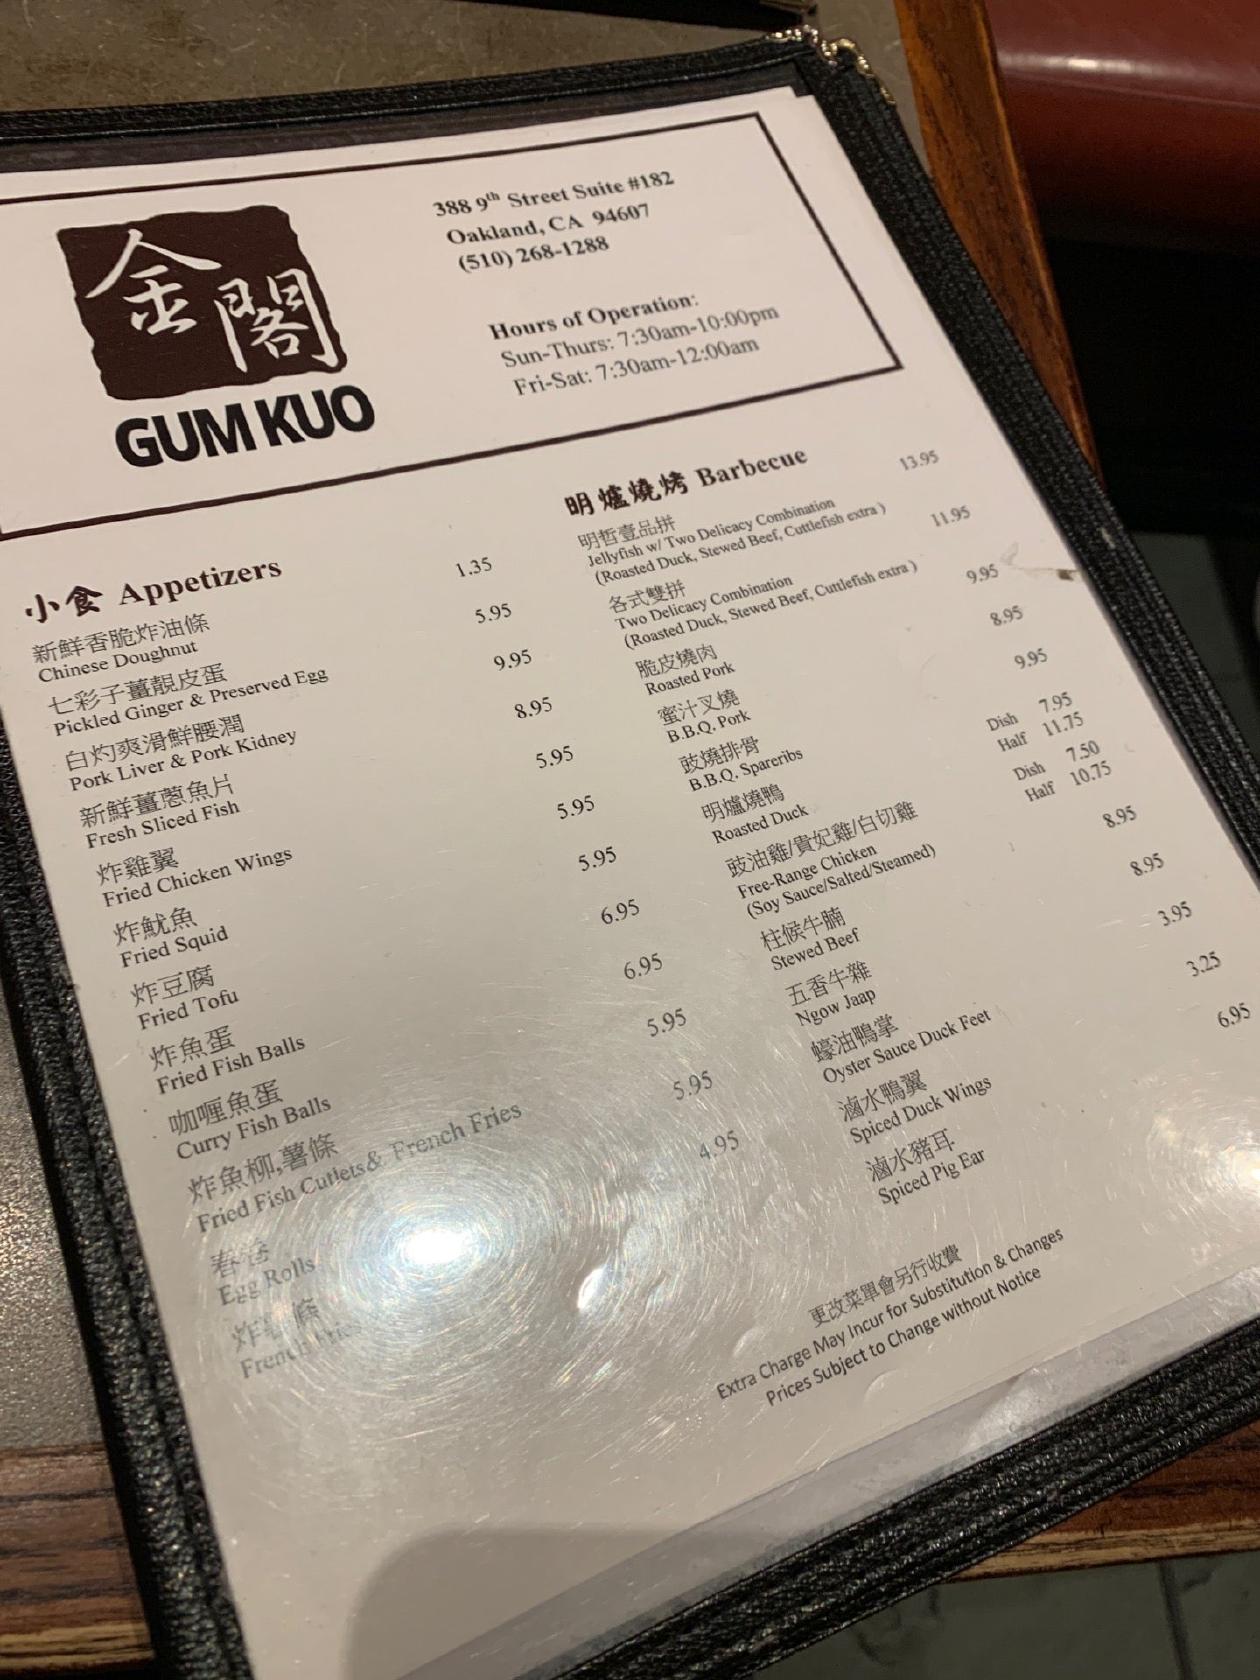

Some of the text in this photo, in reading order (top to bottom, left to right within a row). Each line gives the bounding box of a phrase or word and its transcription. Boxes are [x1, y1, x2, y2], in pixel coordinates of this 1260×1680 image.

[433, 199, 472, 217] 388
[507, 188, 570, 207] Street
[572, 181, 625, 199] Suite
[627, 171, 675, 191] #182
[446, 203, 648, 244] Oakland, CA 94607
[459, 236, 609, 273] (510) 268-1288
[84, 228, 342, 374] 金閣
[488, 295, 698, 340] Hours of Operation:
[501, 308, 779, 368] Sun-Thurs: 7:30am-10:00pm
[513, 340, 759, 396] Fri-Sat: 7:30am-12:00am
[115, 385, 375, 468] GUM KUO
[694, 451, 808, 487] Barbecue
[900, 450, 939, 470] 13.95
[587, 500, 836, 567] Jellyfish Two Delicacy Combination
[931, 506, 970, 527] 11.95
[456, 557, 492, 577] 1.35
[595, 514, 844, 586] (Roasted Duck, Stewed Beef, Cuttlefish
[25, 563, 282, 624] 小食 Appetizers
[966, 564, 998, 584] 9.95
[475, 603, 511, 624] 5.95
[614, 577, 794, 630] Two Delicacy Combination
[990, 605, 1023, 626] 8.95
[32, 613, 210, 663] 新鮮香脆炸油條
[38, 641, 199, 682] Chinese Doughnut
[494, 649, 531, 671] 9.95
[635, 644, 718, 679] 脆皮燒肉
[644, 661, 736, 696] Roasted Pork
[1014, 648, 1047, 669] 9.95
[53, 670, 329, 736] Pickled Ginger Preserved Egg
[514, 697, 552, 718] 8.95
[657, 689, 740, 726] 蜜汁叉燒
[986, 692, 1073, 731] Dish 7.95
[666, 709, 751, 743] B.B.Q. Pork
[997, 712, 1084, 752] Half 11.75
[69, 731, 296, 791] Pork Liver Pork Kidney
[536, 745, 573, 769] 5.95
[678, 736, 760, 774] 豉燒排骨
[688, 749, 803, 792] B.B.Q. Spareribs
[1012, 740, 1100, 780] Dish 7.50
[1025, 760, 1112, 802] Half 10.75
[557, 795, 594, 819] 5.95
[701, 784, 785, 823] 明爐燒鴨
[1102, 805, 1136, 828] 8.95
[85, 801, 240, 849] Fresh Sliced Fish
[711, 804, 809, 844] Roasted Duck
[96, 847, 179, 886] 炸雞翼
[102, 850, 293, 907] Fried Chicken Wings
[579, 846, 616, 871] 5.95
[736, 845, 878, 899] Free-Range Chicken
[1130, 853, 1164, 876] 8.95
[113, 907, 198, 947] 炸魷魚
[601, 899, 639, 924] 6.95
[747, 898, 779, 920] (Soy
[1158, 901, 1192, 926] 3.95
[120, 925, 229, 968] Fried Squid
[760, 907, 846, 952] 柱候牛腩
[771, 927, 860, 971] Stewed Beef
[624, 953, 662, 979] 6.95
[785, 961, 872, 1006] 五香牛雜
[1186, 951, 1221, 977] 3.25
[130, 964, 214, 1007] 炸豆腐
[137, 990, 239, 1030] Fried Tofu
[647, 1008, 687, 1038] 5.95
[794, 990, 876, 1026] Ngow Jaap
[1217, 1002, 1250, 1028] 6.95
[149, 1025, 235, 1072] 炸魚蛋
[810, 1014, 899, 1064] 蠔油鴨掌
[823, 1009, 991, 1083] Oyster Sauce Duck Feet
[156, 1037, 305, 1095] Fried Fish Balls
[673, 1070, 714, 1101] 5.95
[836, 1070, 927, 1122] 滷水鴨翼
[850, 1078, 991, 1144] Spiced Duck Wings
[177, 1097, 331, 1159] Curry Fish Balls
[198, 1104, 522, 1232] Fried Fish Fries
[865, 1128, 955, 1182] 滷水豬耳
[878, 1150, 984, 1204] Spiced Pig Ear
[716, 1229, 1063, 1400] Extra Charge May Incur for Substitution Changes
[766, 1268, 1041, 1406] Prices Subject to Change without Notice
